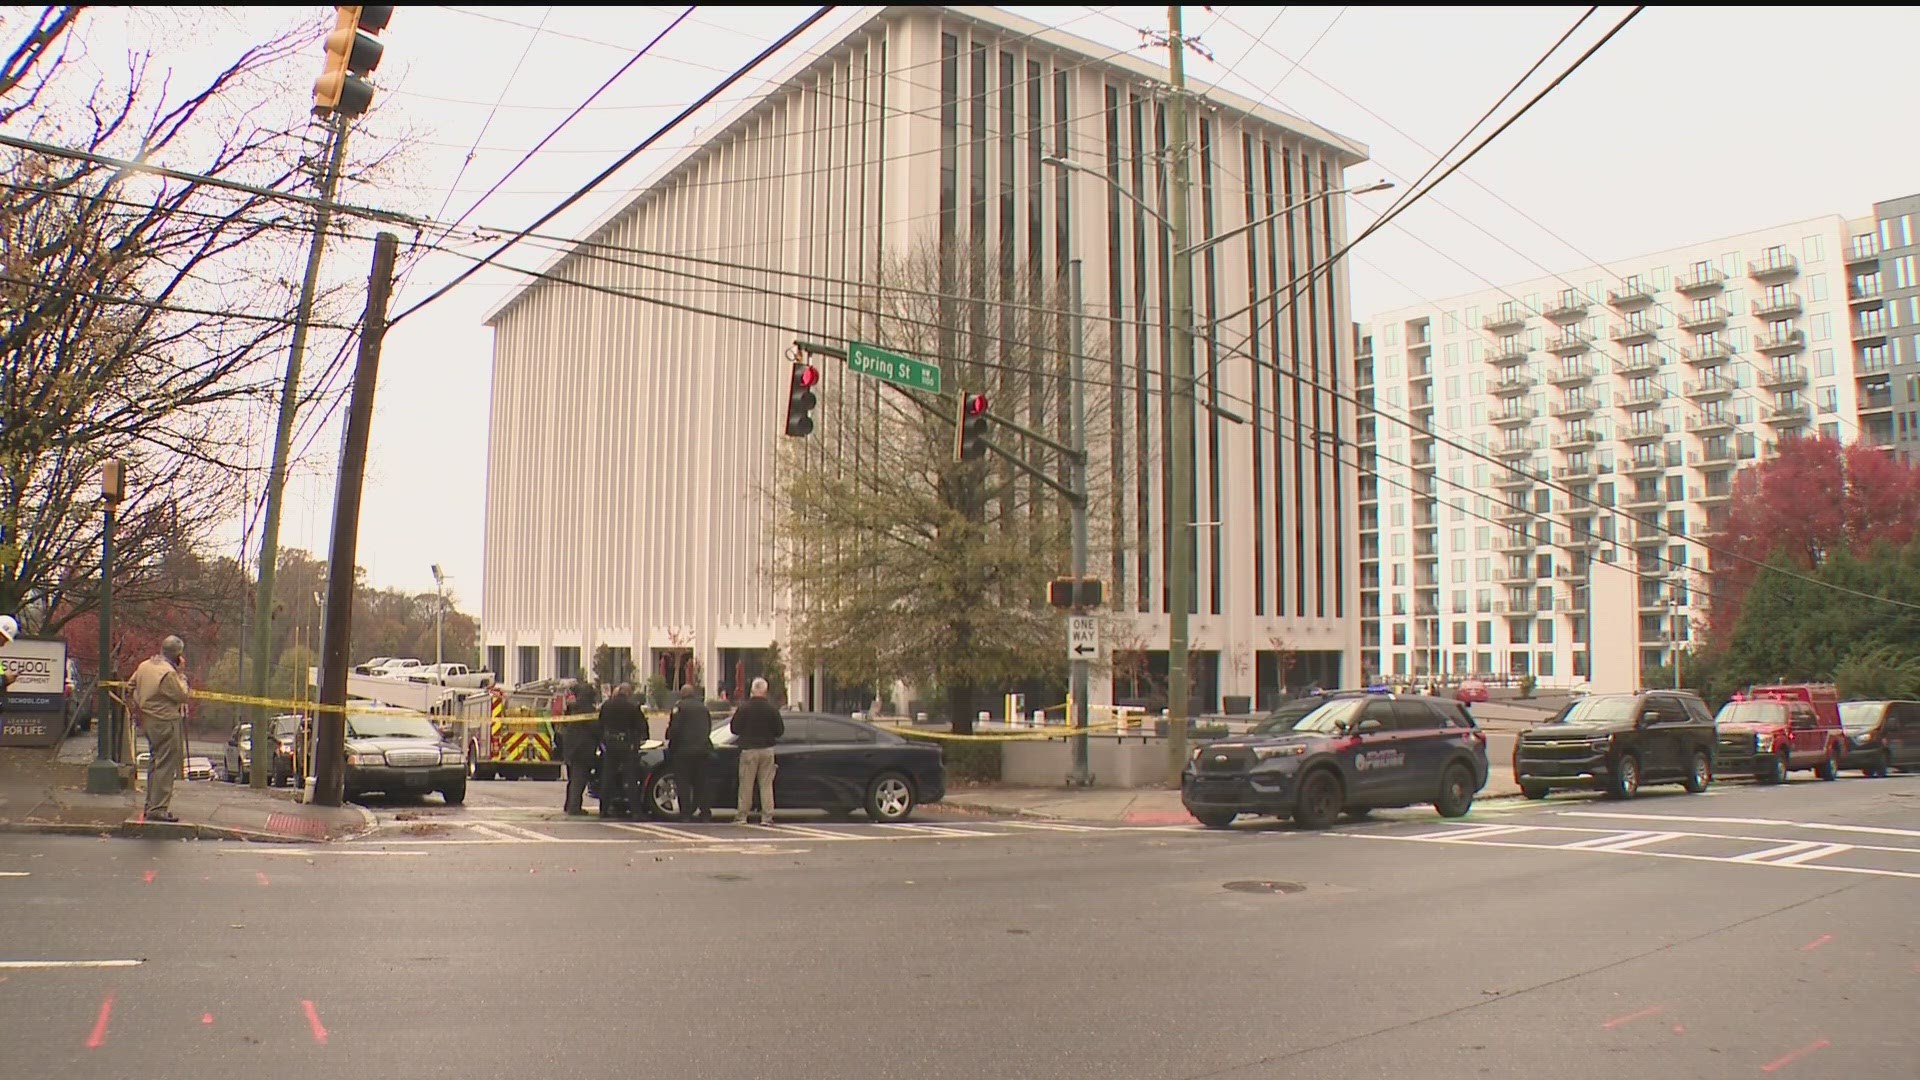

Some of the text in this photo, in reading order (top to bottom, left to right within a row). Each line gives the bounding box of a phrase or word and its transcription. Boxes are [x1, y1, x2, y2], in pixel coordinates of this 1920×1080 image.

[854, 350, 911, 379] Spring St
[1073, 619, 1094, 630] ONE
[1073, 630, 1095, 641] WAY
[1, 660, 50, 673] SCHOOL
[3, 726, 22, 735] FOR
